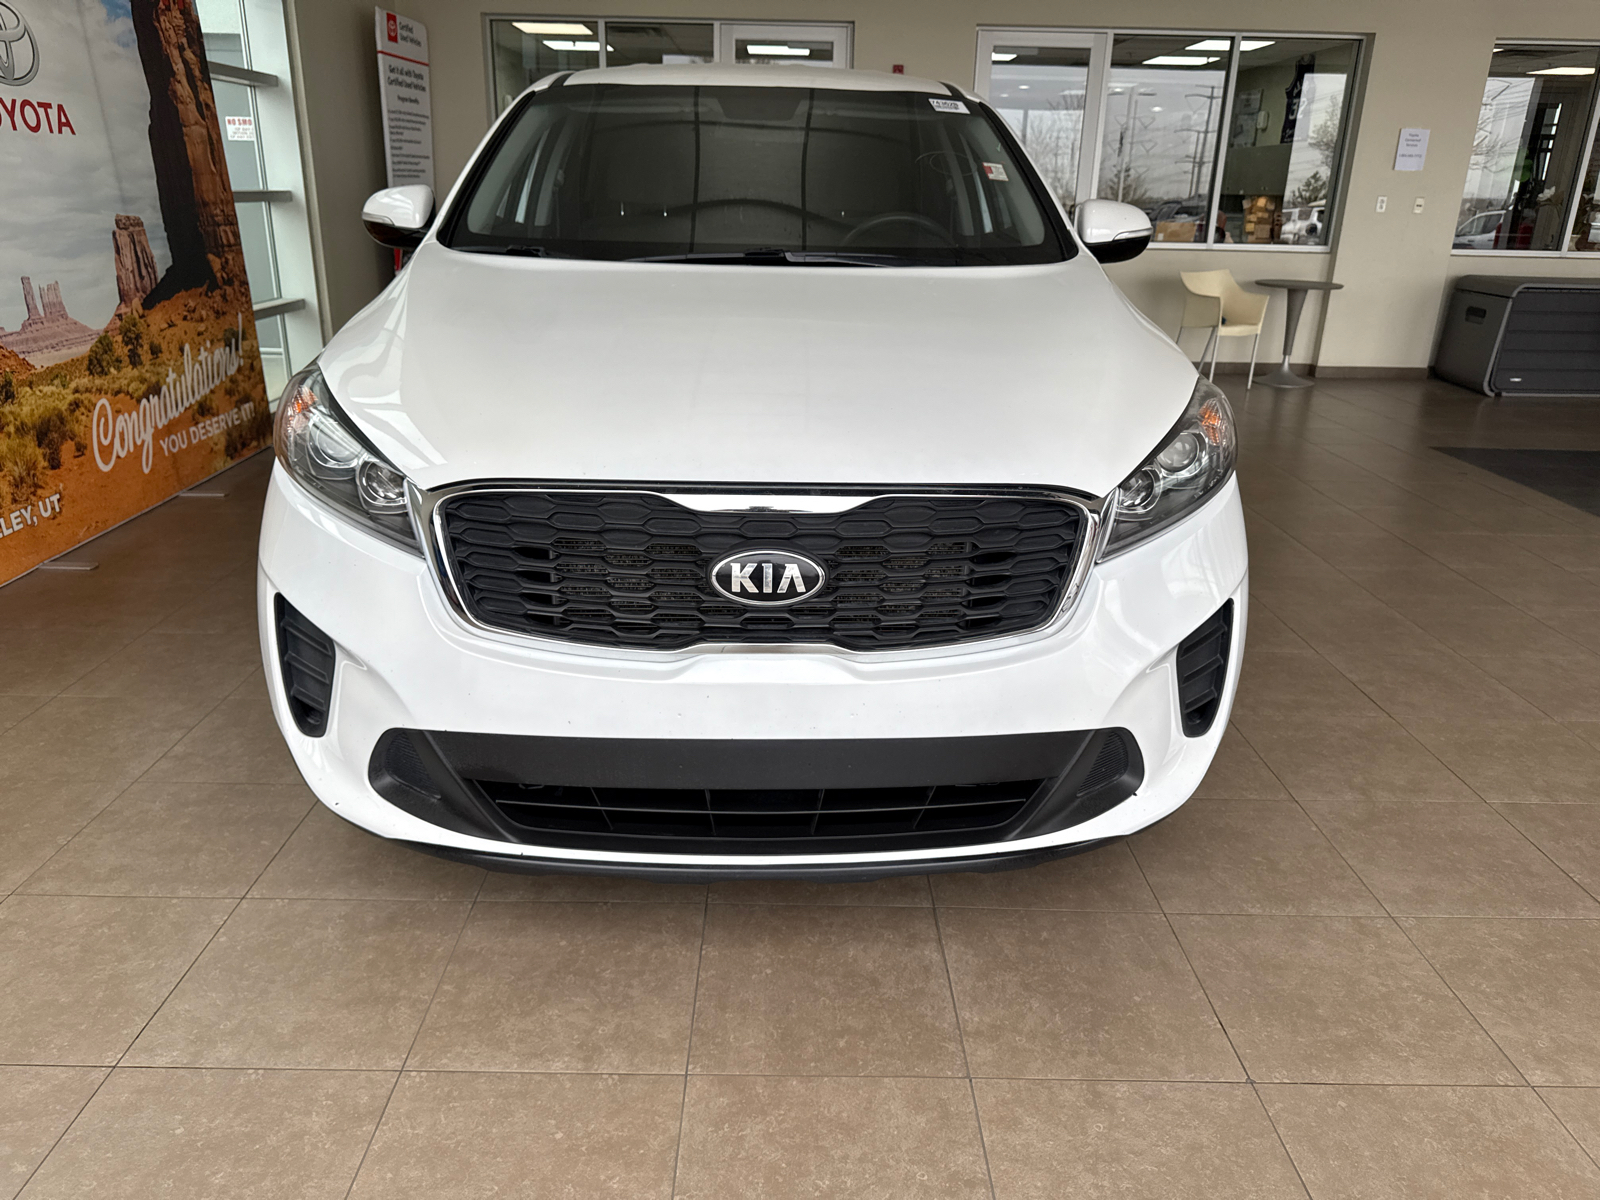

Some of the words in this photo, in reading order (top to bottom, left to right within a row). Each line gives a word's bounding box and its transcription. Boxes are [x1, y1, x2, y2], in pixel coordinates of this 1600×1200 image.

[0, 97, 76, 136] YOTA
[92, 311, 244, 475] Congratulations!
[159, 430, 188, 457] YOU
[189, 408, 241, 444] DESERVE
[0, 505, 38, 539] LEY,
[38, 493, 60, 518] UT
[730, 562, 807, 594] KIA
